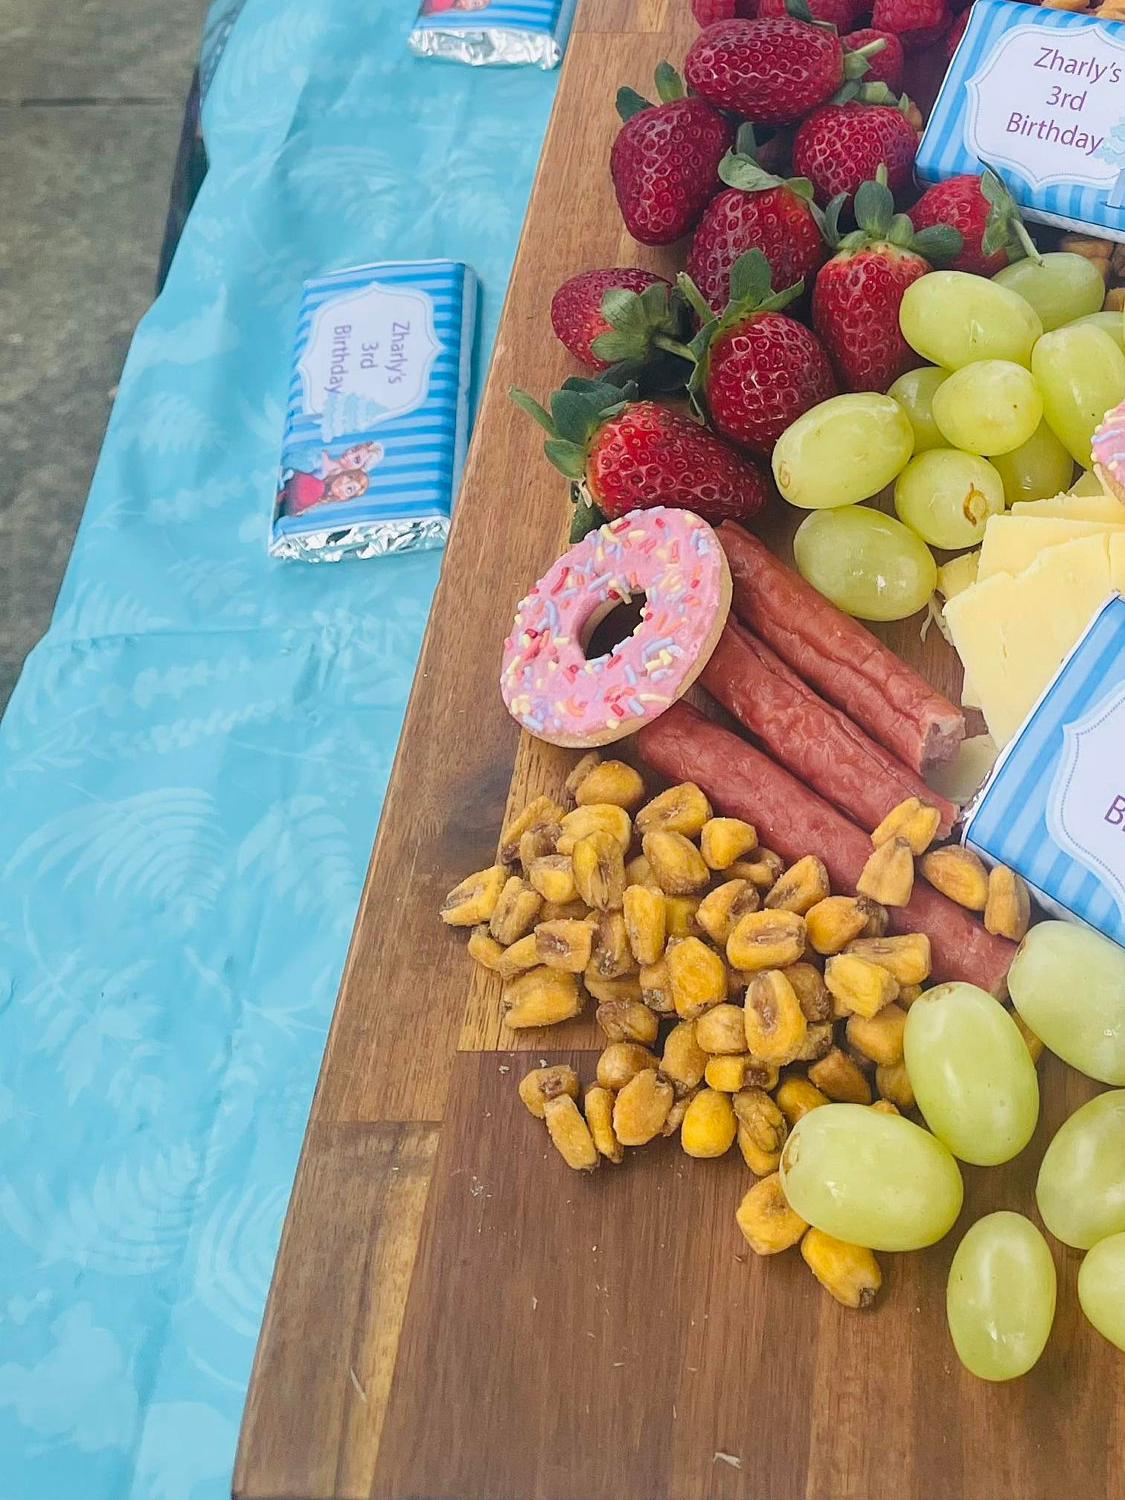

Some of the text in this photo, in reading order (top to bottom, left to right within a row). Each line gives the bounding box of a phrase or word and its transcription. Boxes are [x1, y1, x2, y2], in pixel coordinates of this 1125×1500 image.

[1033, 46, 1122, 84] Zharly's
[1046, 85, 1088, 112] 3rd
[1006, 112, 1105, 156] Birthday
[323, 324, 352, 394] Birthday
[359, 341, 380, 369] 3rd
[388, 321, 411, 385] Zharly's
